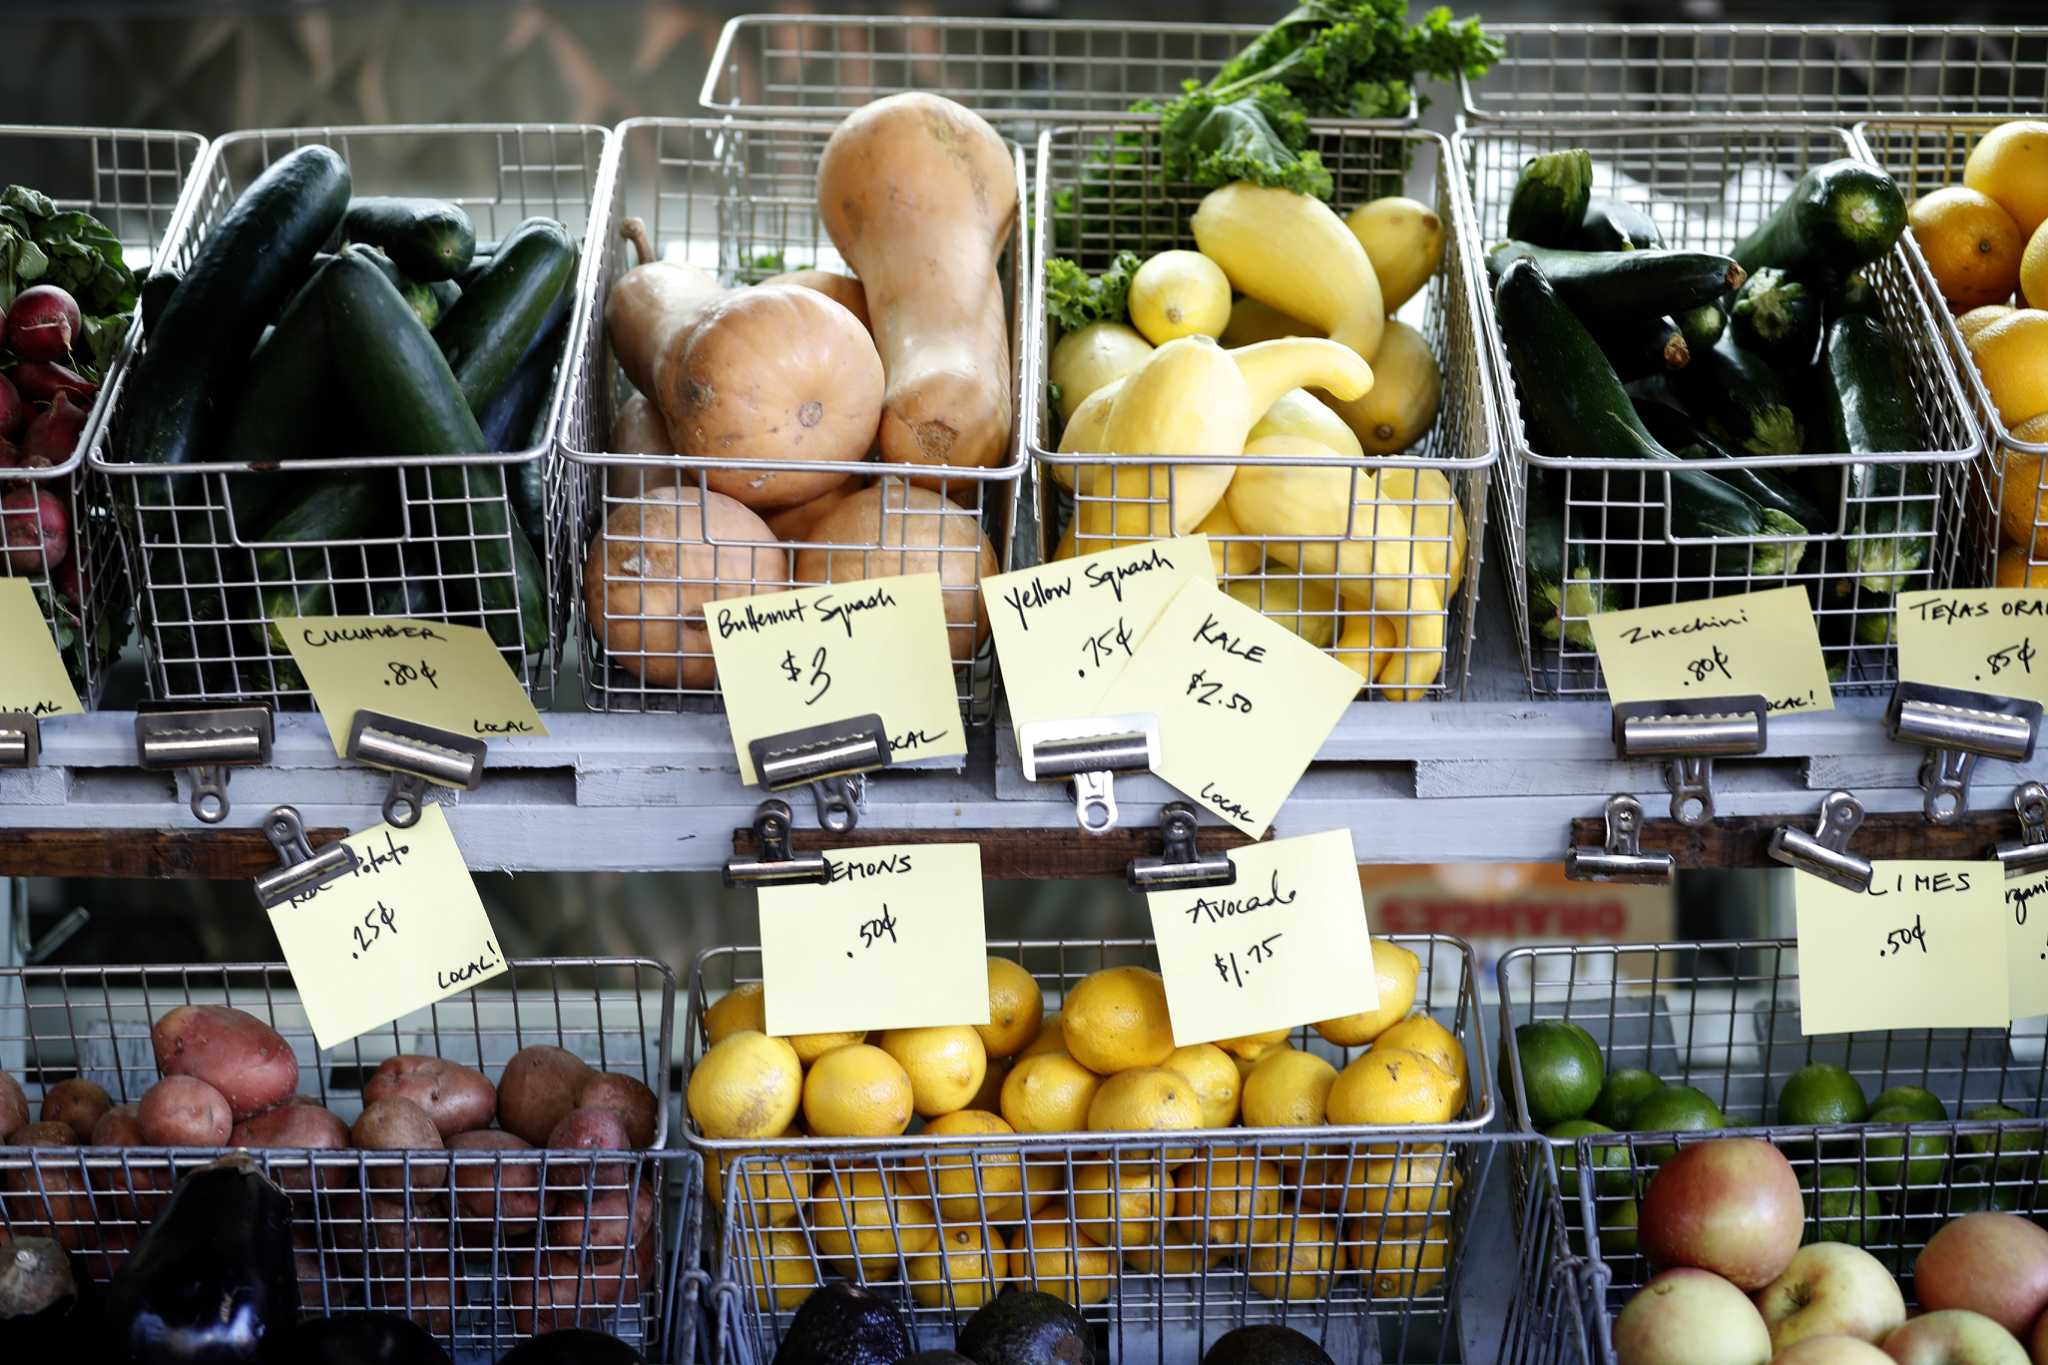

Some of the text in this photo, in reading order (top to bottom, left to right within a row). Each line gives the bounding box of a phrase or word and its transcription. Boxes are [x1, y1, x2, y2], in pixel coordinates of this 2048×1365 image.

[1085, 549, 1174, 602] Squash
[717, 588, 896, 639] Butternut Squash
[1620, 609, 1750, 645] Zucchini
[1909, 597, 2048, 625] TEXAS ORA
[303, 624, 447, 647] CUCUMBER
[1193, 613, 1266, 663] KALE
[384, 660, 438, 689] .80¢
[780, 646, 831, 705] $3
[1186, 670, 1253, 714] $2.50
[1766, 690, 1816, 711] OCAL!
[474, 719, 534, 734] LOCAL
[889, 729, 948, 751] OCAL
[1200, 782, 1255, 823] LOCAL
[832, 854, 912, 882] EMONS
[1866, 872, 1971, 896] LIMES
[1186, 869, 1297, 924] Avocado
[352, 900, 397, 959] .25¢
[1880, 914, 1927, 957] .50¢
[438, 941, 500, 989] LOCAL!
[1214, 933, 1282, 987] $1.75
